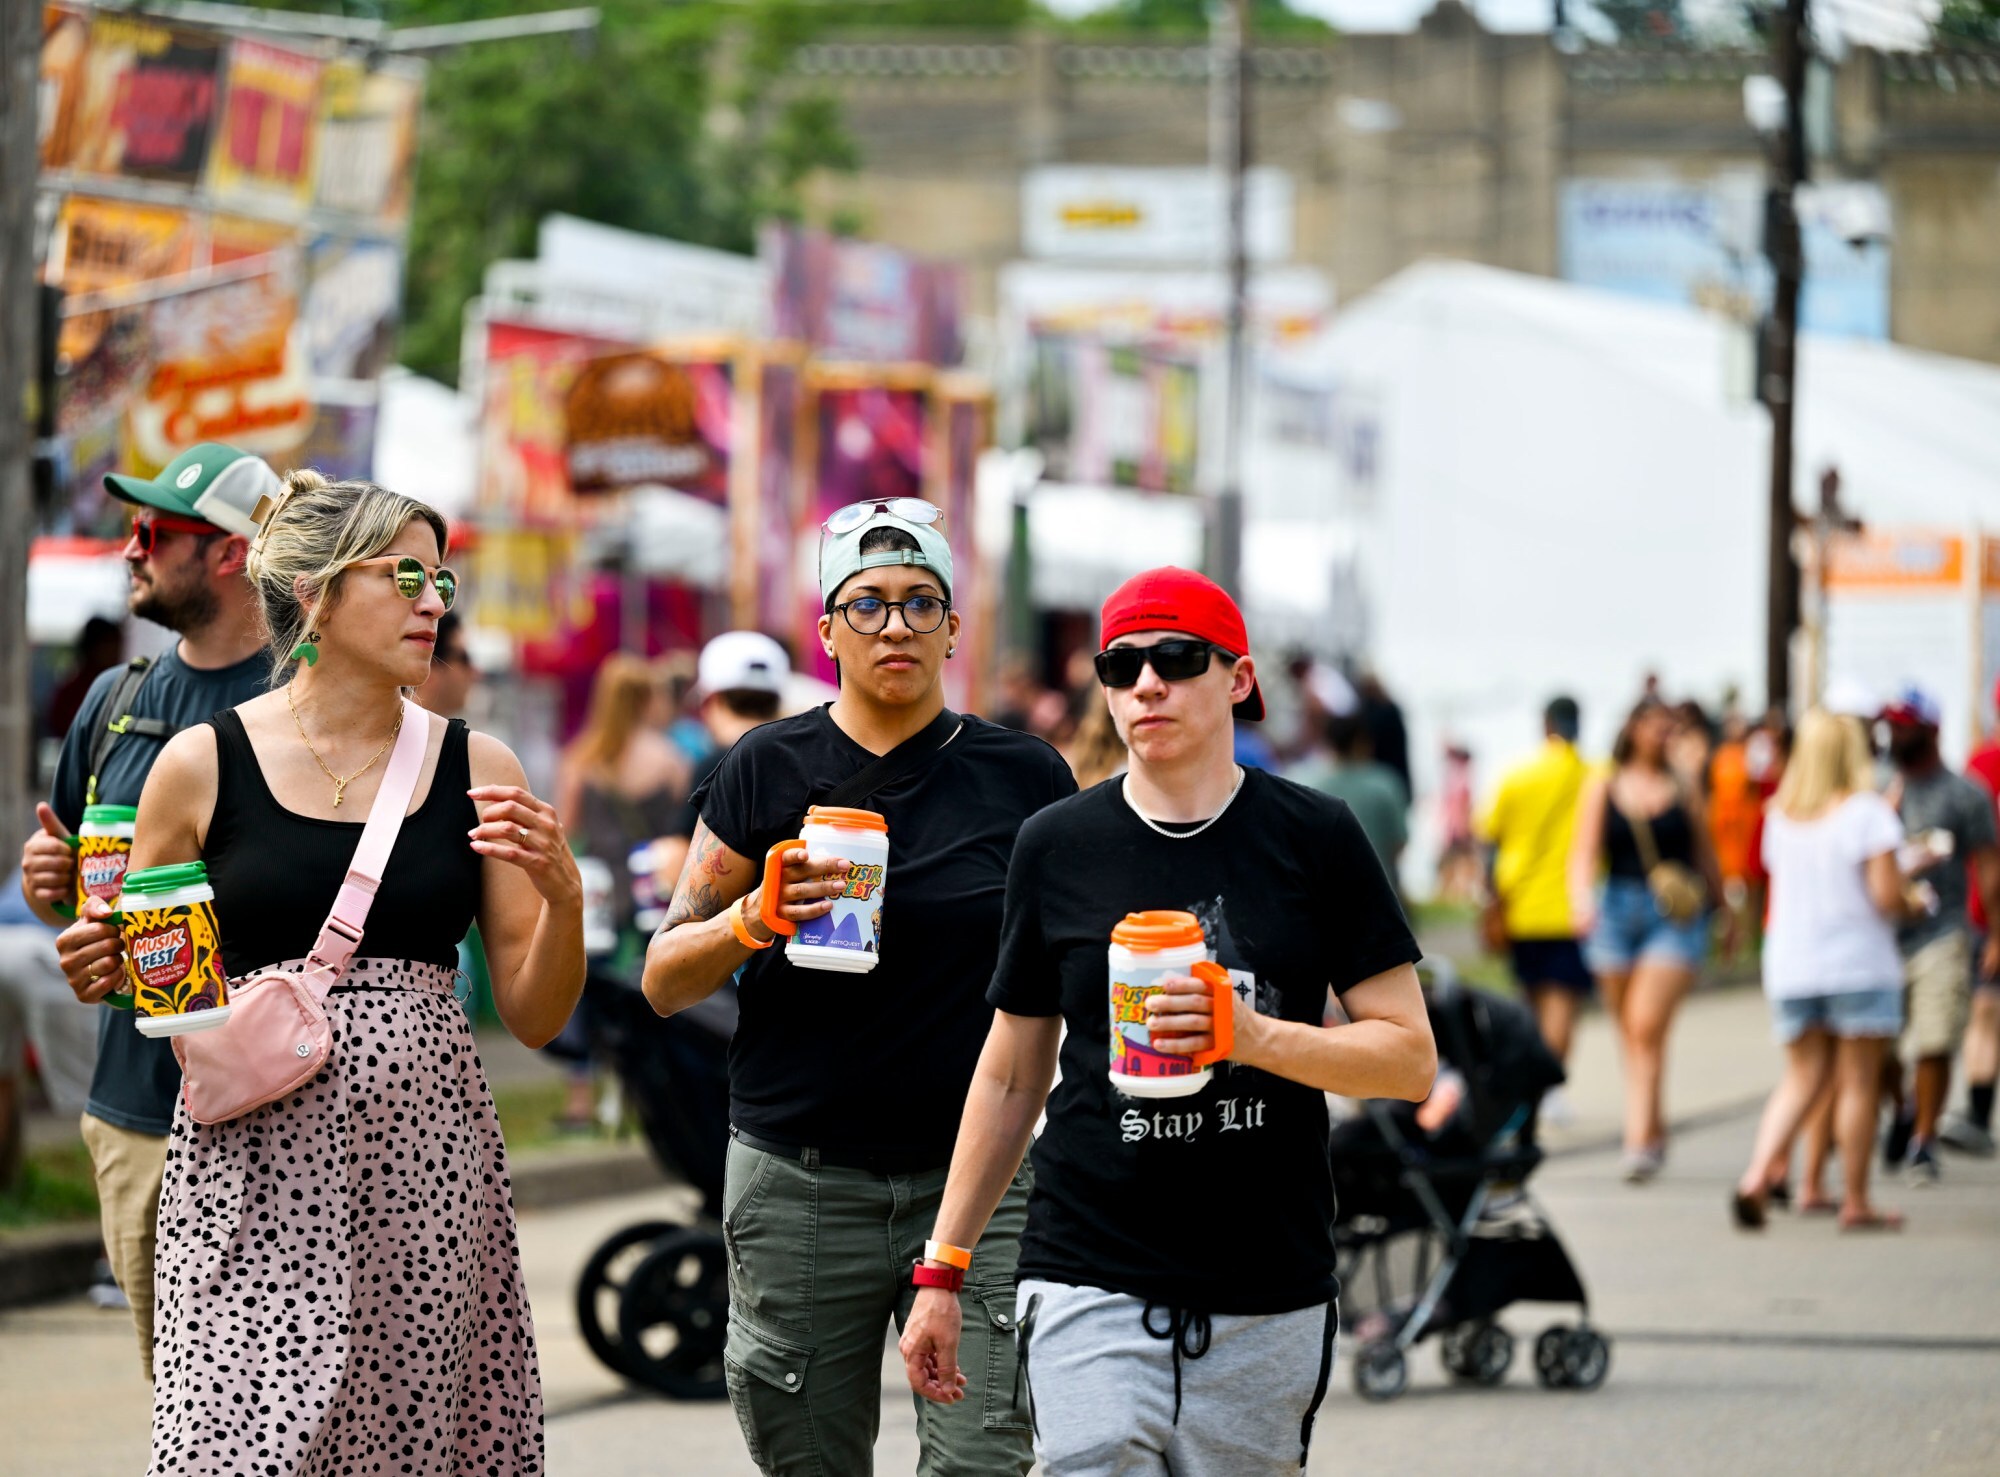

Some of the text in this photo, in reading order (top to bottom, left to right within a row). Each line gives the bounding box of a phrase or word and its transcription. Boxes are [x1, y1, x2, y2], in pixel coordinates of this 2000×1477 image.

[82, 854, 127, 876] MUSIK
[86, 871, 115, 889] FEST
[831, 880, 874, 900] EST
[133, 928, 186, 958] MUSIK
[140, 946, 177, 973] FEST
[1120, 1097, 1266, 1142] Stay Lit
